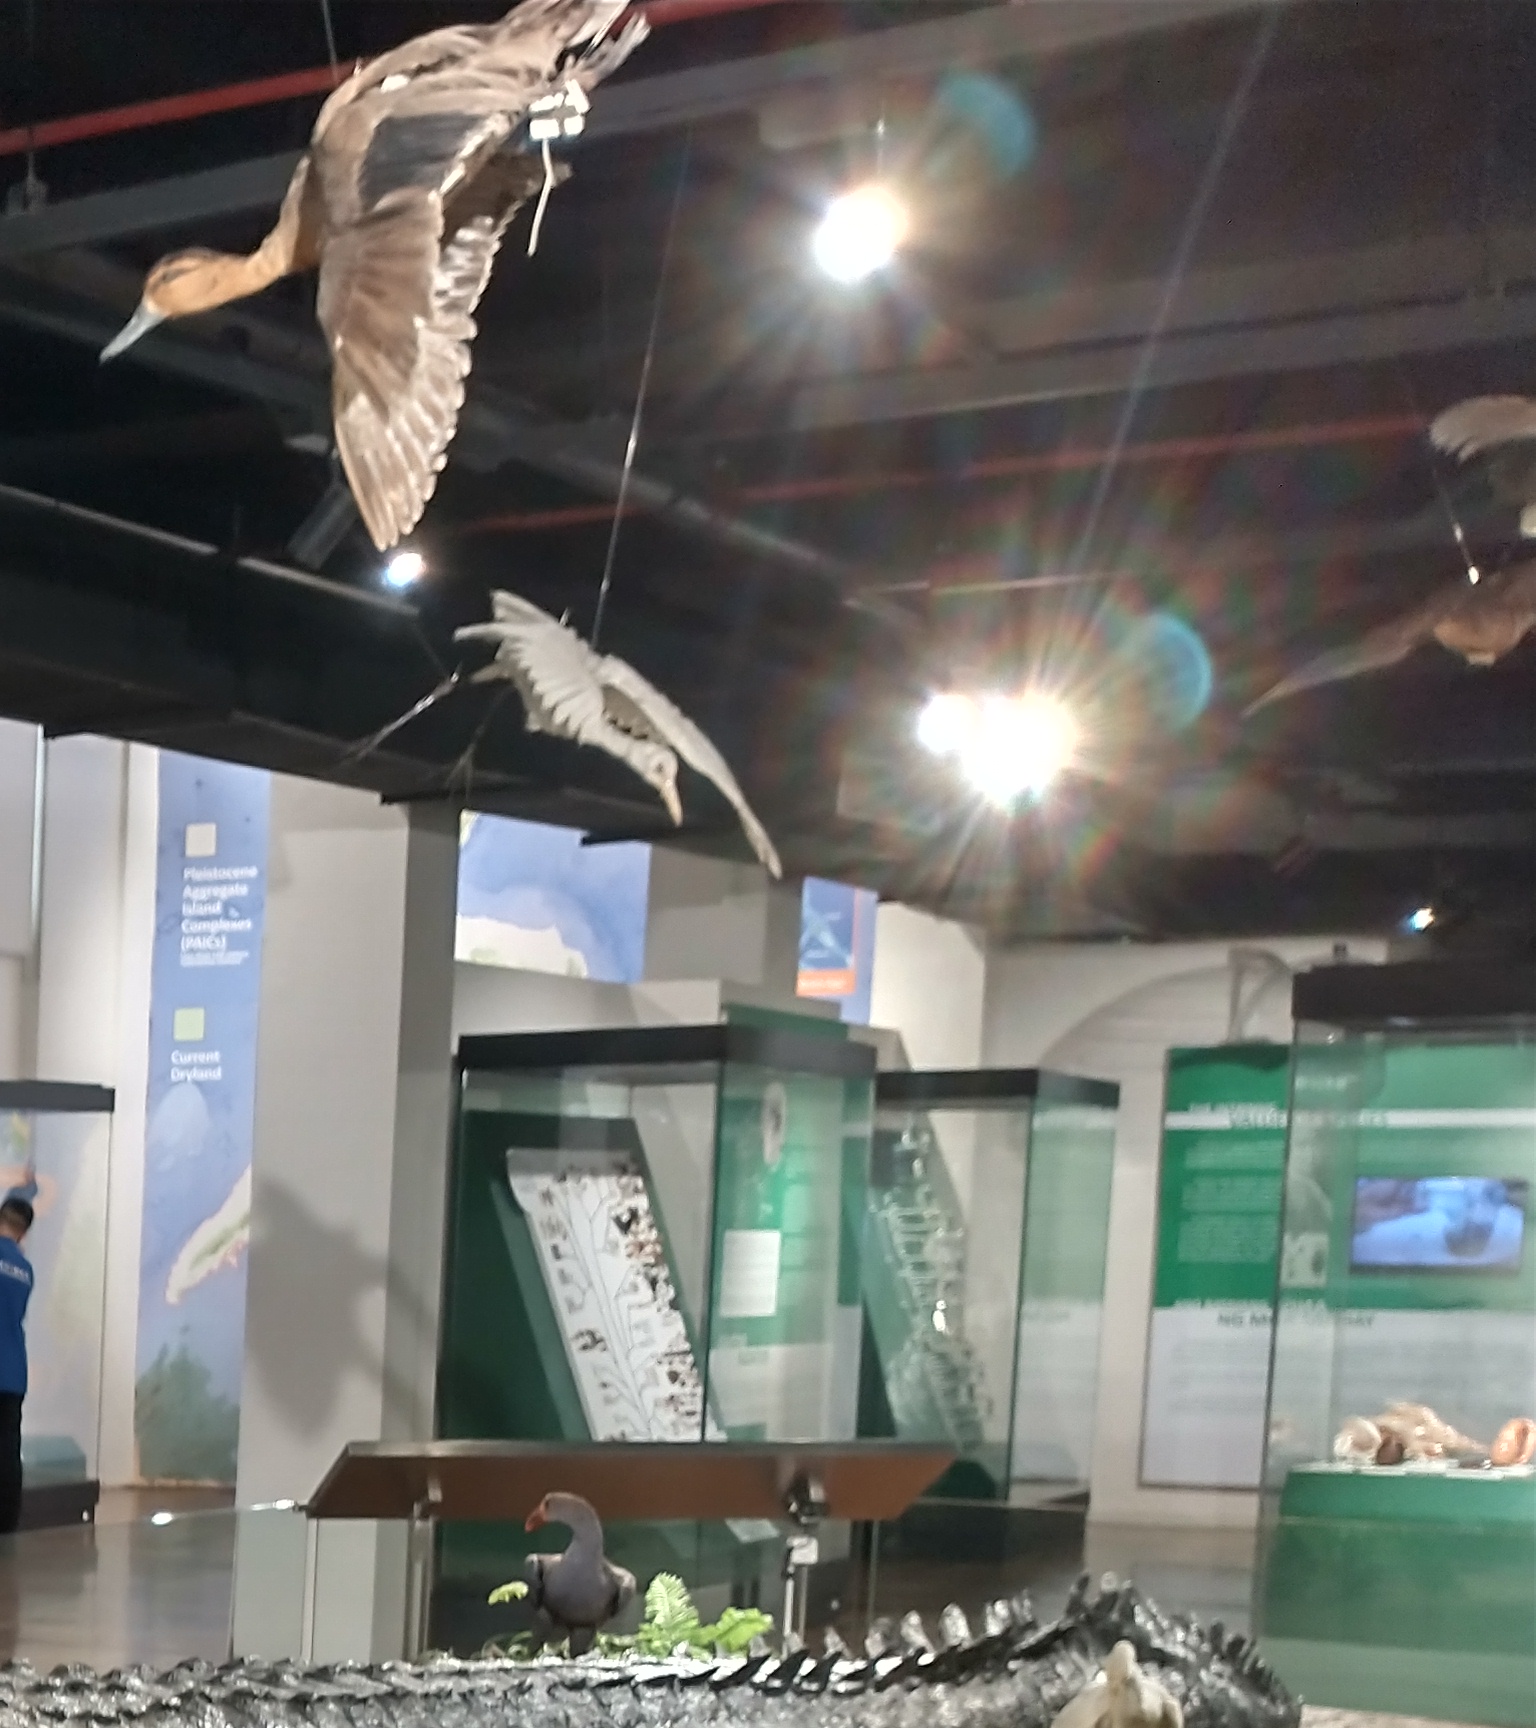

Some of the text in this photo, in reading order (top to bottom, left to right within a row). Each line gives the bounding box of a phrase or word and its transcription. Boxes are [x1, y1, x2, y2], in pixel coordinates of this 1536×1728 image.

[182, 900, 222, 916] Island
[171, 1050, 220, 1064] Current
[171, 1066, 222, 1084] Dryland
